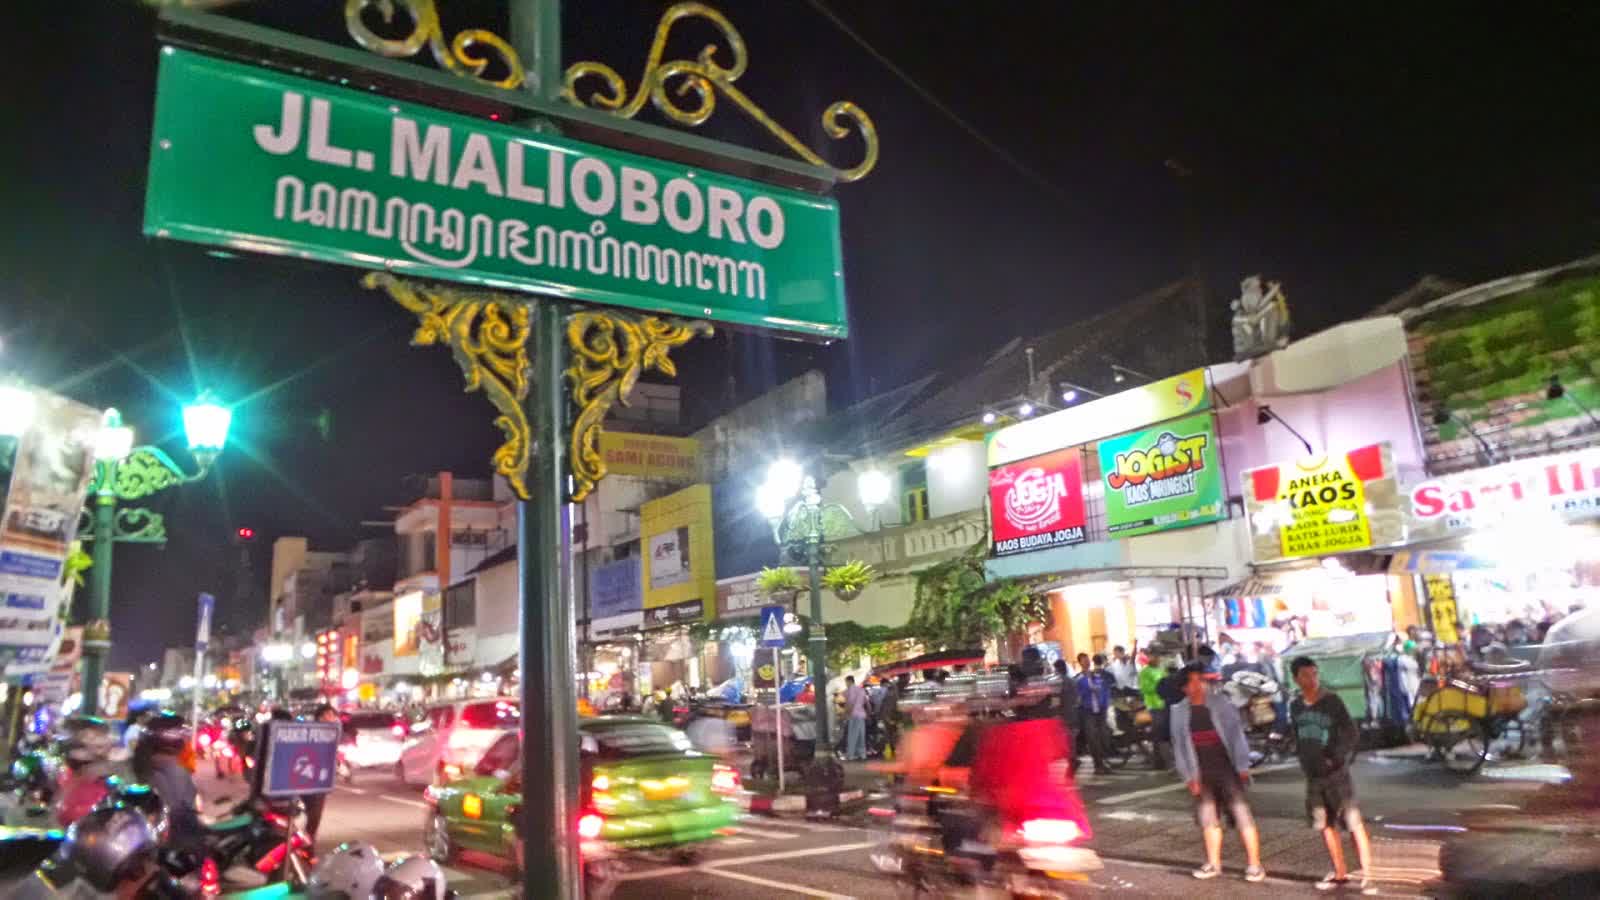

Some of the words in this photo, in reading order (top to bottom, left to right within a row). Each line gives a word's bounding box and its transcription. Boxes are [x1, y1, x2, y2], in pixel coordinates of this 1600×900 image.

[253, 90, 374, 172] JL.
[391, 115, 786, 250] MALIOBORO
[1289, 470, 1343, 490] ANEKA
[996, 540, 1019, 553] KAOS
[1019, 532, 1053, 549] BUDAYA
[1053, 526, 1084, 543] JOGJA
